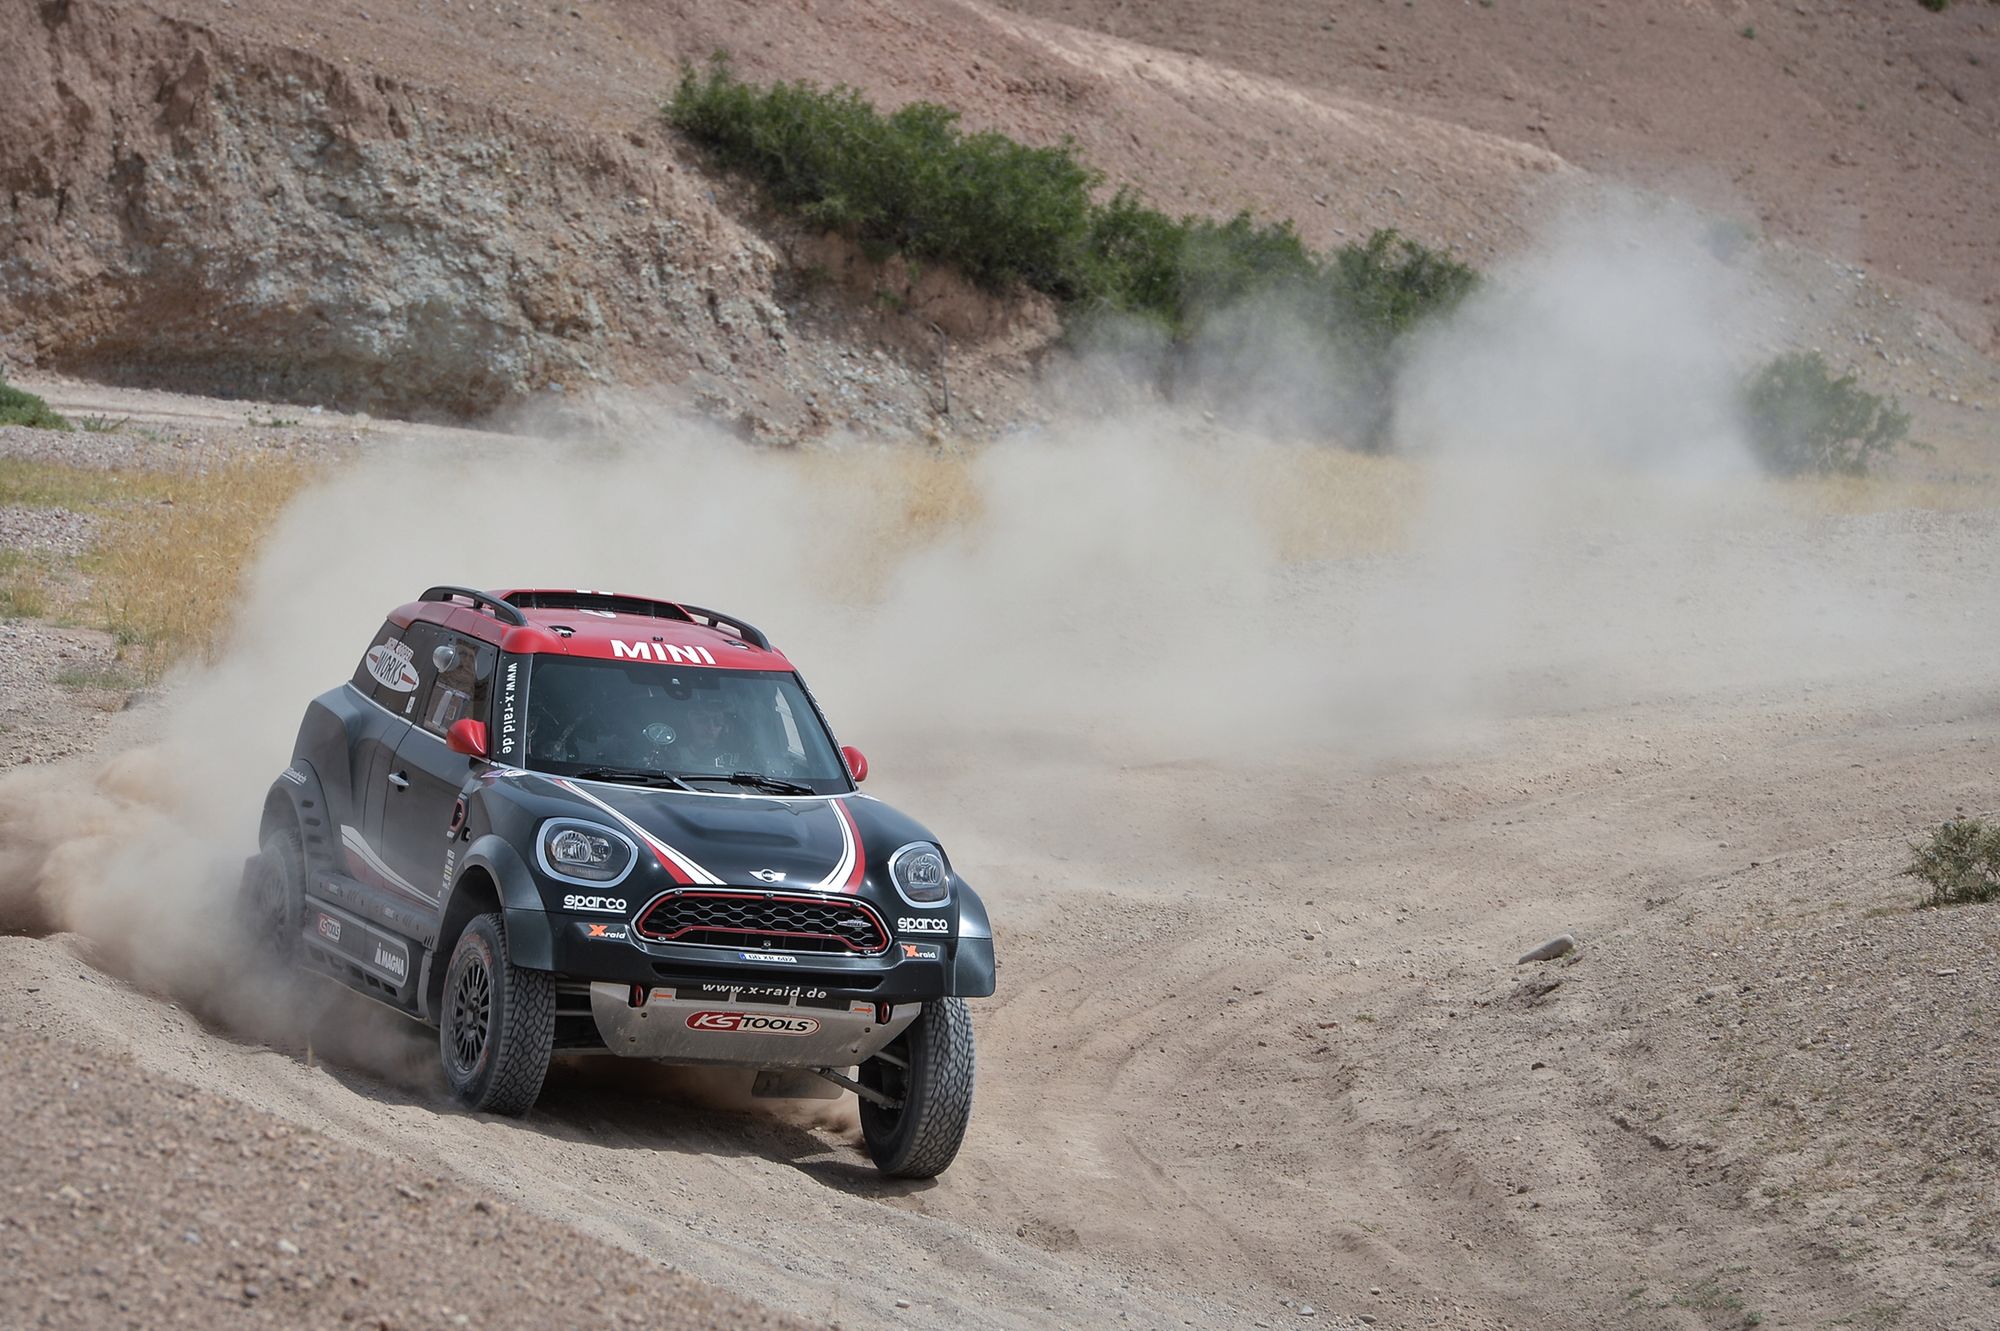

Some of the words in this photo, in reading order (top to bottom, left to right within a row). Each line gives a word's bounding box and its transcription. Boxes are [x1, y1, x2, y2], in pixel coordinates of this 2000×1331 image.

[610, 639, 716, 665] MINI
[373, 650, 407, 686] WORKS
[502, 662, 518, 754] www.x-raid.de
[563, 894, 627, 914] sparco
[897, 917, 949, 933] sparco
[702, 983, 827, 999] www.x-raid.de
[740, 1016, 808, 1032] TOOLS
